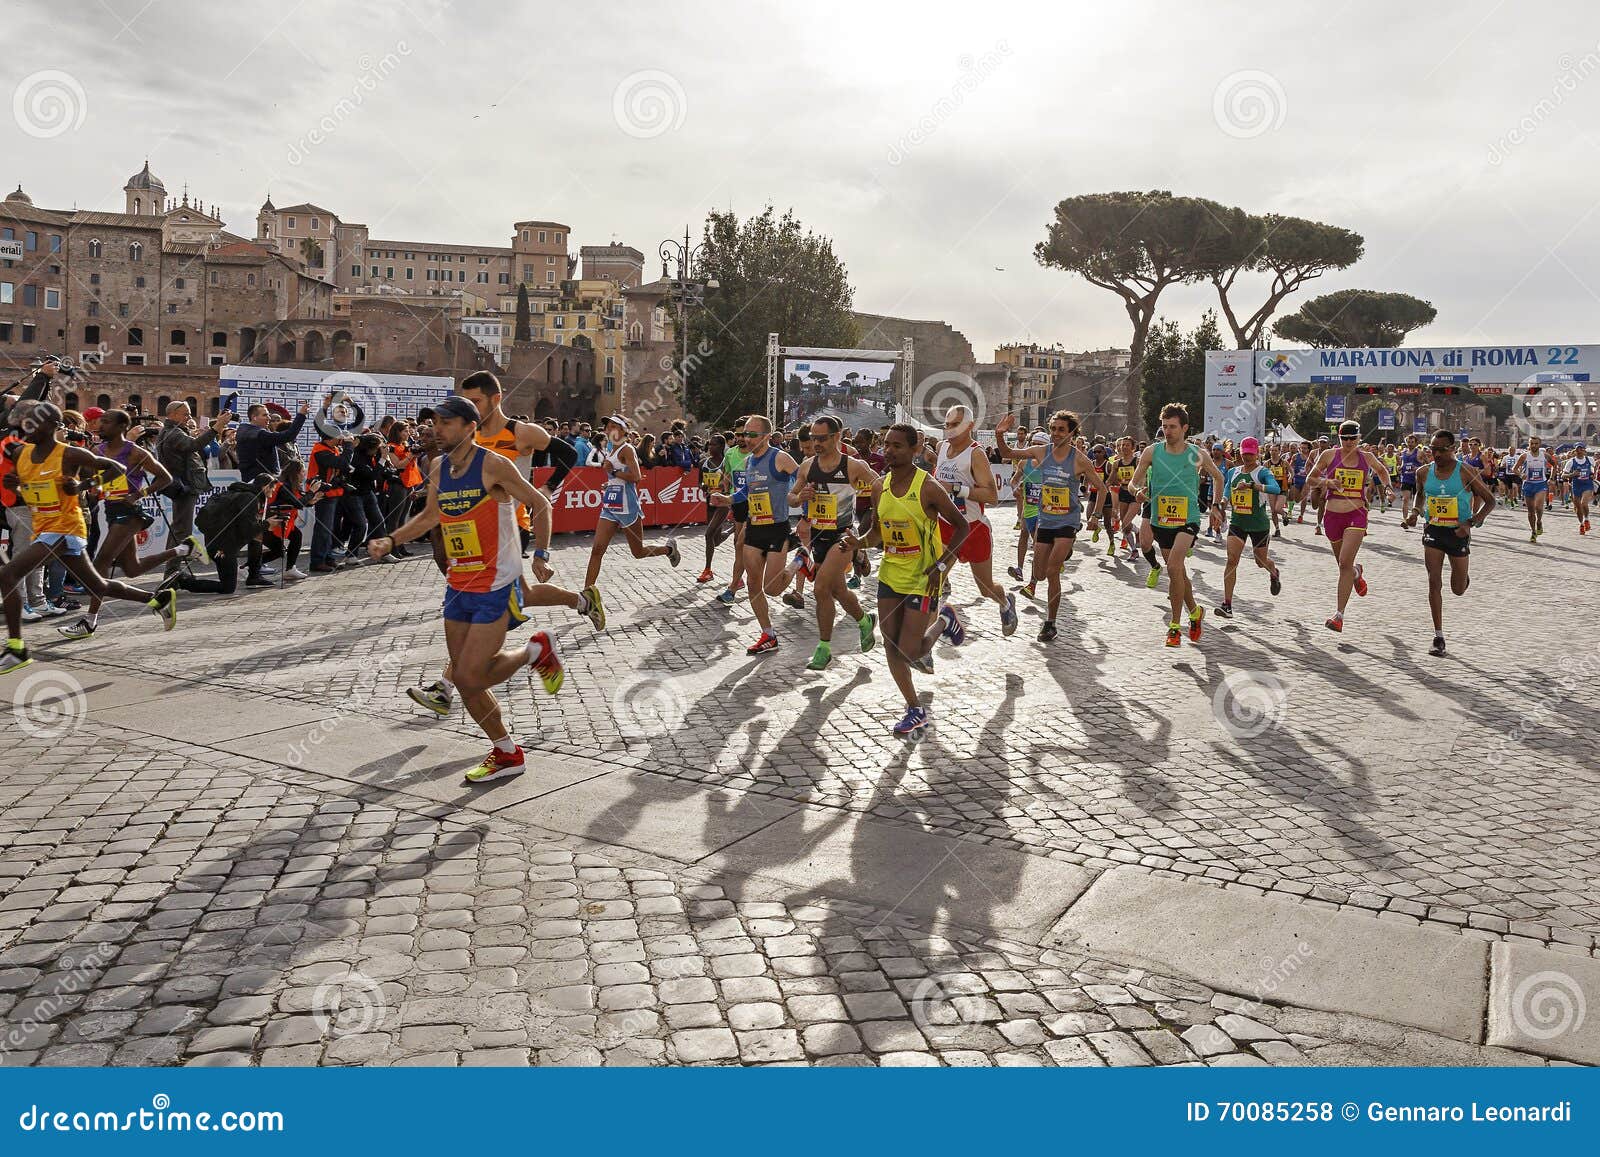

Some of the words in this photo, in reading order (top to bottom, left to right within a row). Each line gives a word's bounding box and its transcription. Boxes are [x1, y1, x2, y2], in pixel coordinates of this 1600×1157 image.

[1320, 350, 1435, 367] MARATONA
[1443, 350, 1462, 366] di
[1472, 349, 1538, 366] ROMA
[1548, 347, 1579, 364] 22
[1347, 477, 1356, 485] 13
[816, 504, 826, 514] 46
[1166, 505, 1177, 513] 42
[1436, 506, 1448, 514] 35
[891, 531, 904, 542] 44
[450, 537, 464, 551] 13
